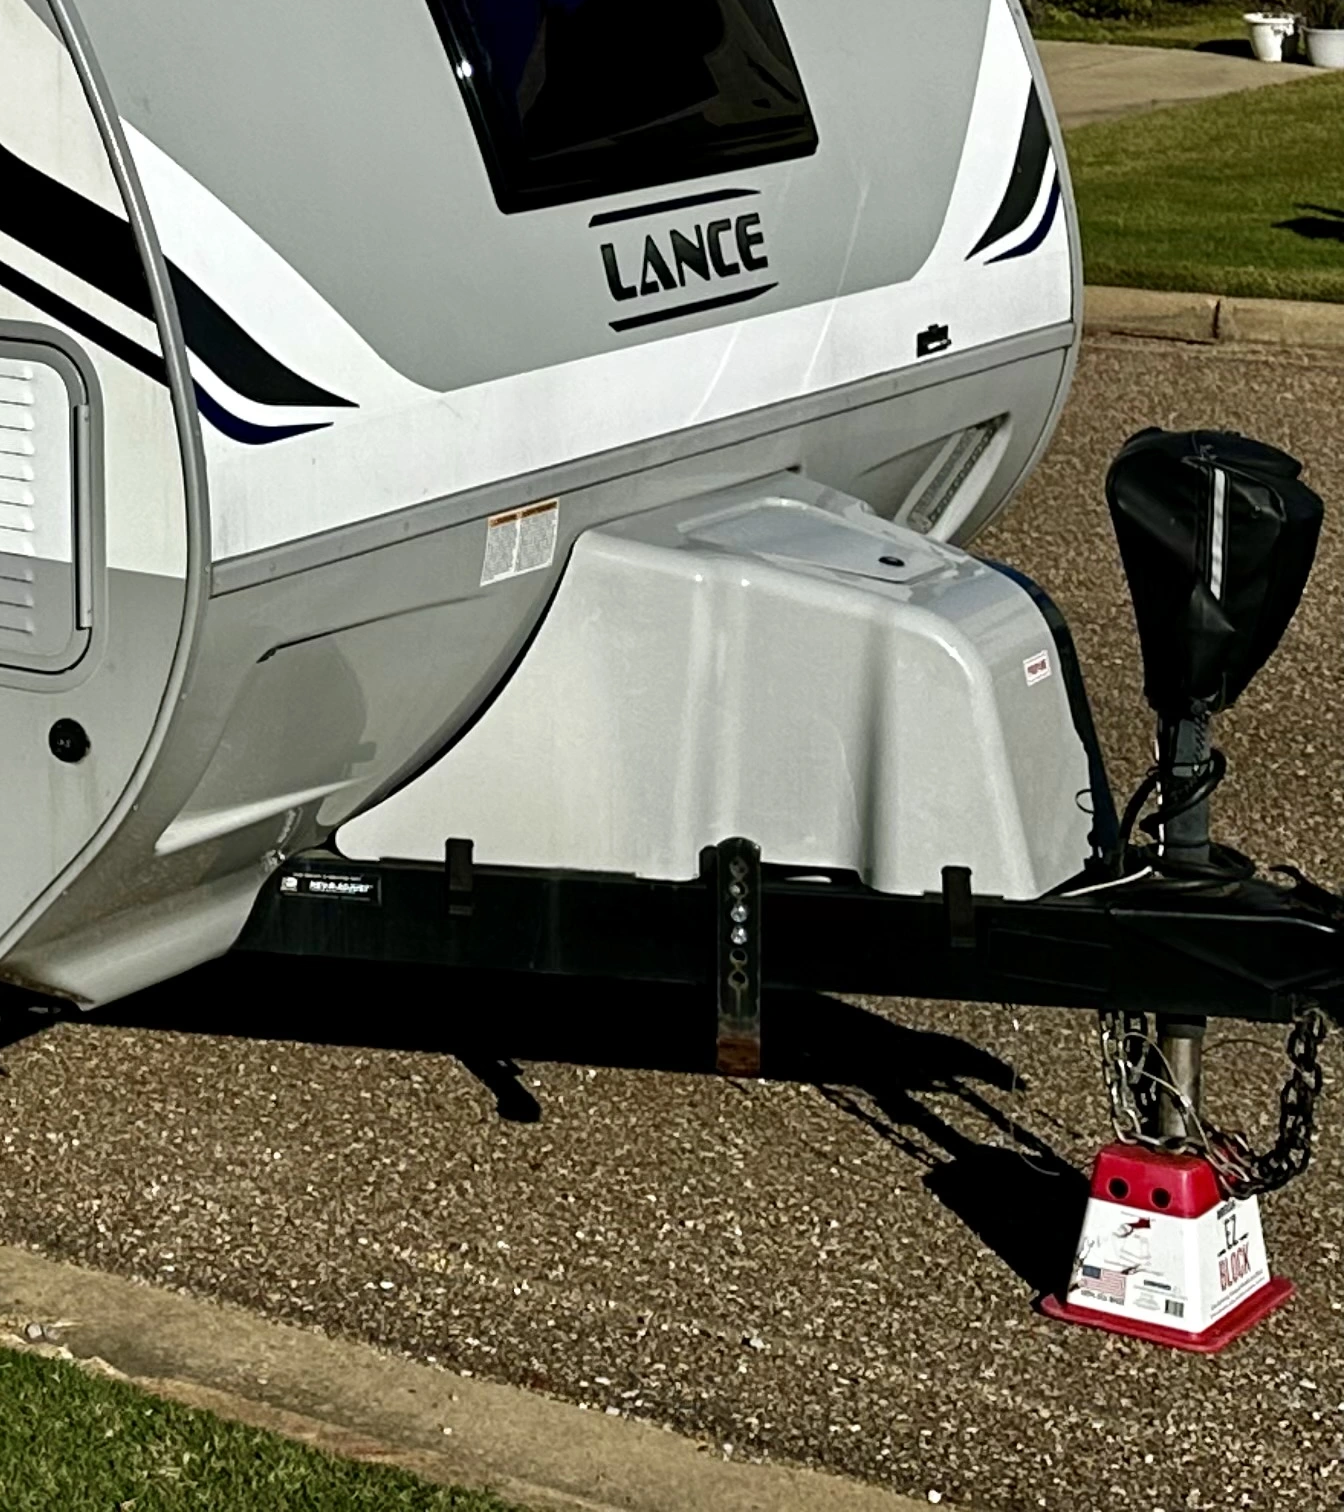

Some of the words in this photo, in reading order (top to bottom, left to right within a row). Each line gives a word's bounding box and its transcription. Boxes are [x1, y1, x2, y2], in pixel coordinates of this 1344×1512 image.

[600, 212, 768, 302] LANCE
[1224, 1214, 1239, 1250] EZ
[1218, 1241, 1251, 1292] BLOCK
